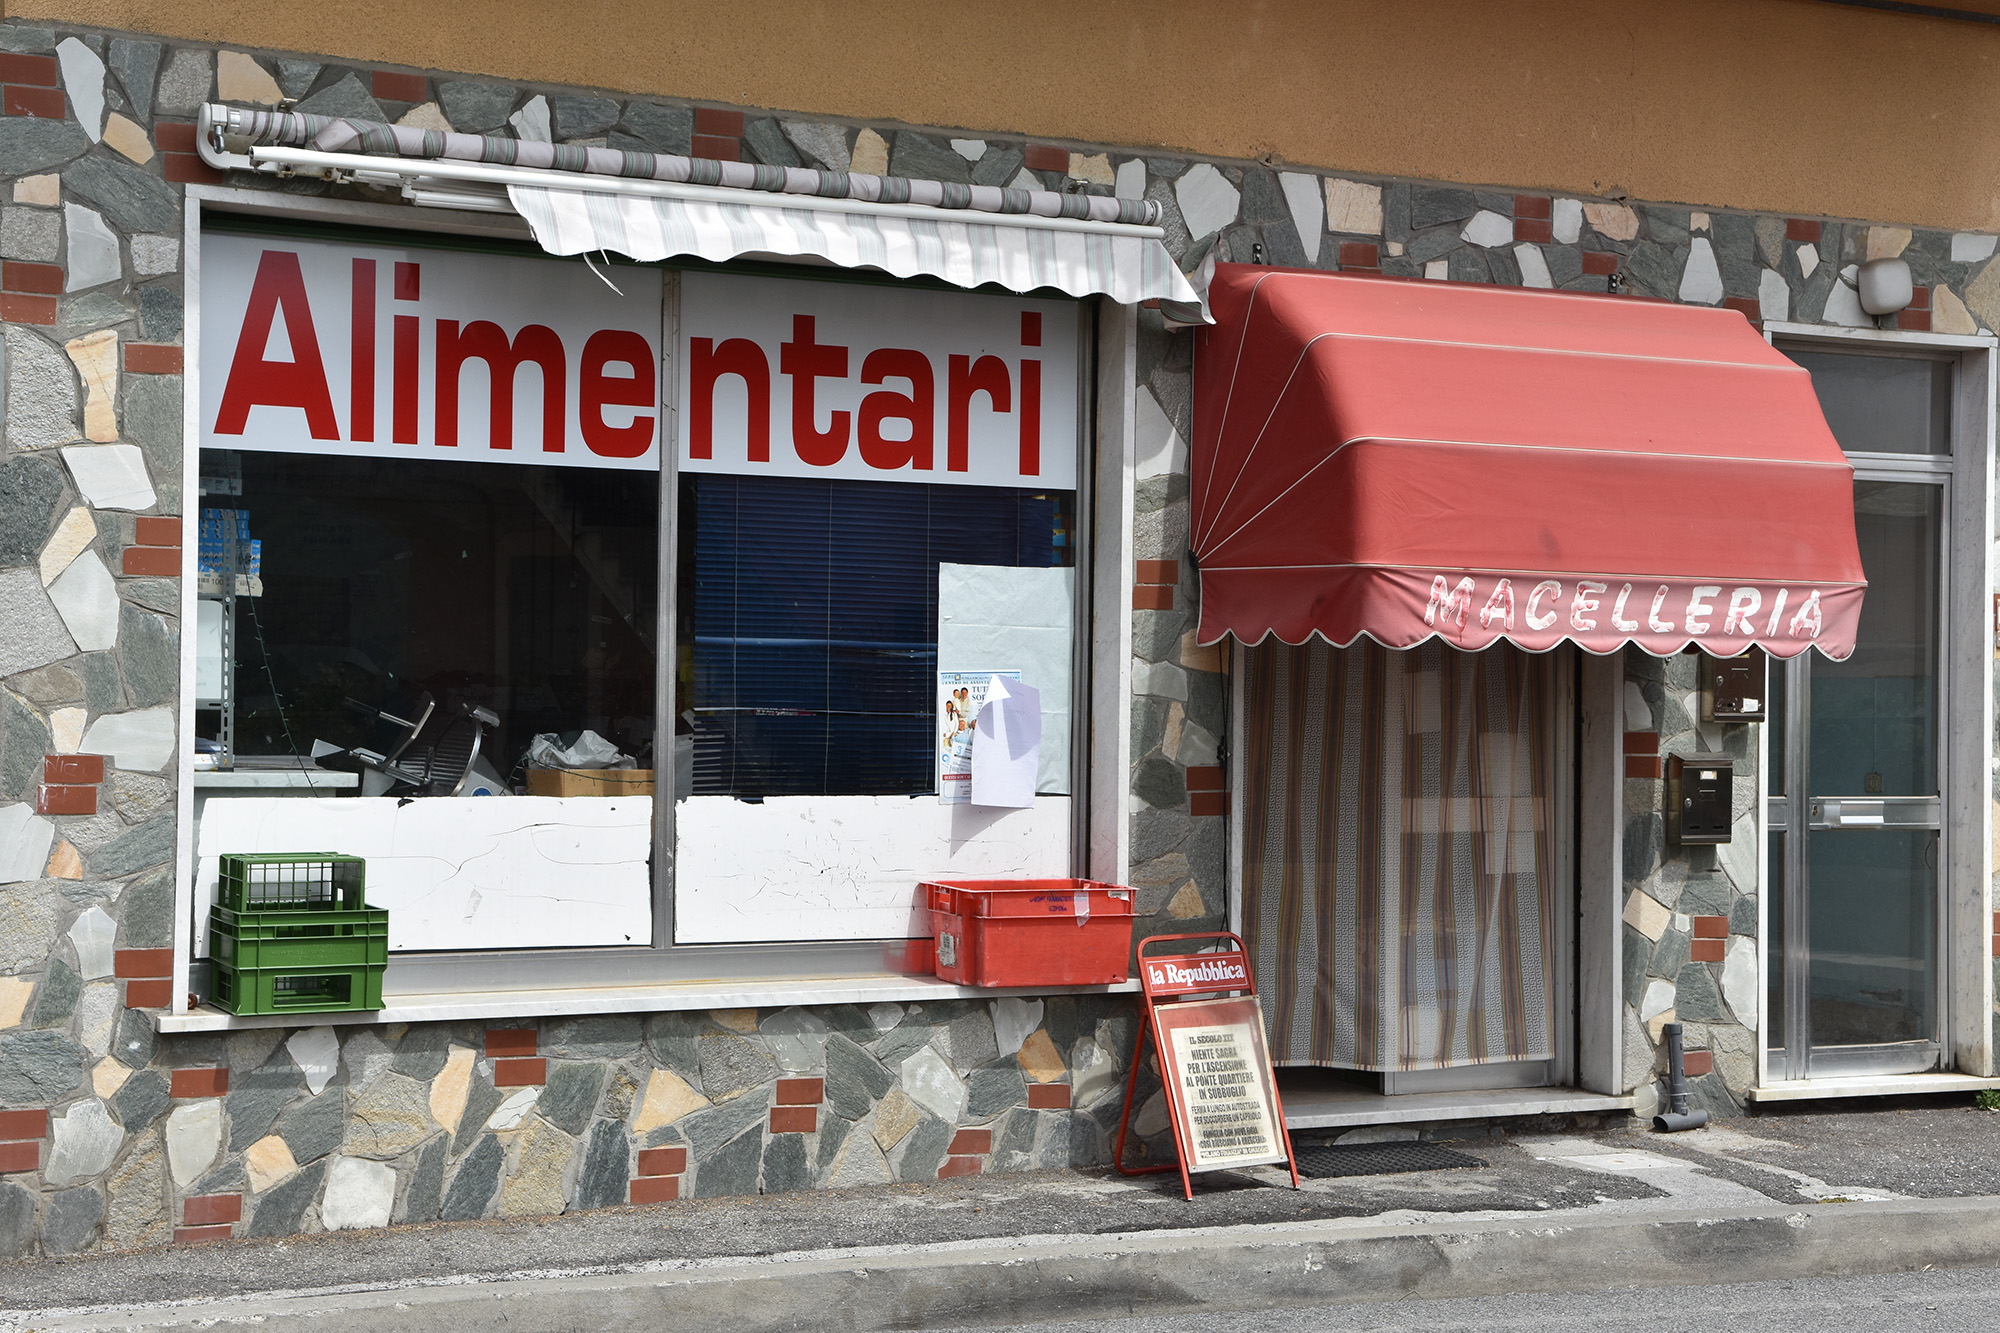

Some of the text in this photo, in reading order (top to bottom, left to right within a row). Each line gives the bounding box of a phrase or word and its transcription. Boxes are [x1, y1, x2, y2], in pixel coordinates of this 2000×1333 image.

[213, 249, 1042, 476] Alimentari
[1424, 575, 1822, 639] MACELLERIA
[1149, 960, 1245, 987] la Repubblica
[1189, 1036, 1196, 1045] IL
[1197, 1034, 1222, 1045] SECOLO
[1223, 1034, 1235, 1043] XIX
[1191, 1046, 1238, 1061] NIENTE SAGRA
[1187, 1062, 1200, 1074] PER
[1185, 1072, 1255, 1087] AL PONTE QUARTIERE
[1198, 1085, 1247, 1100] IN SUBBUGLIO
